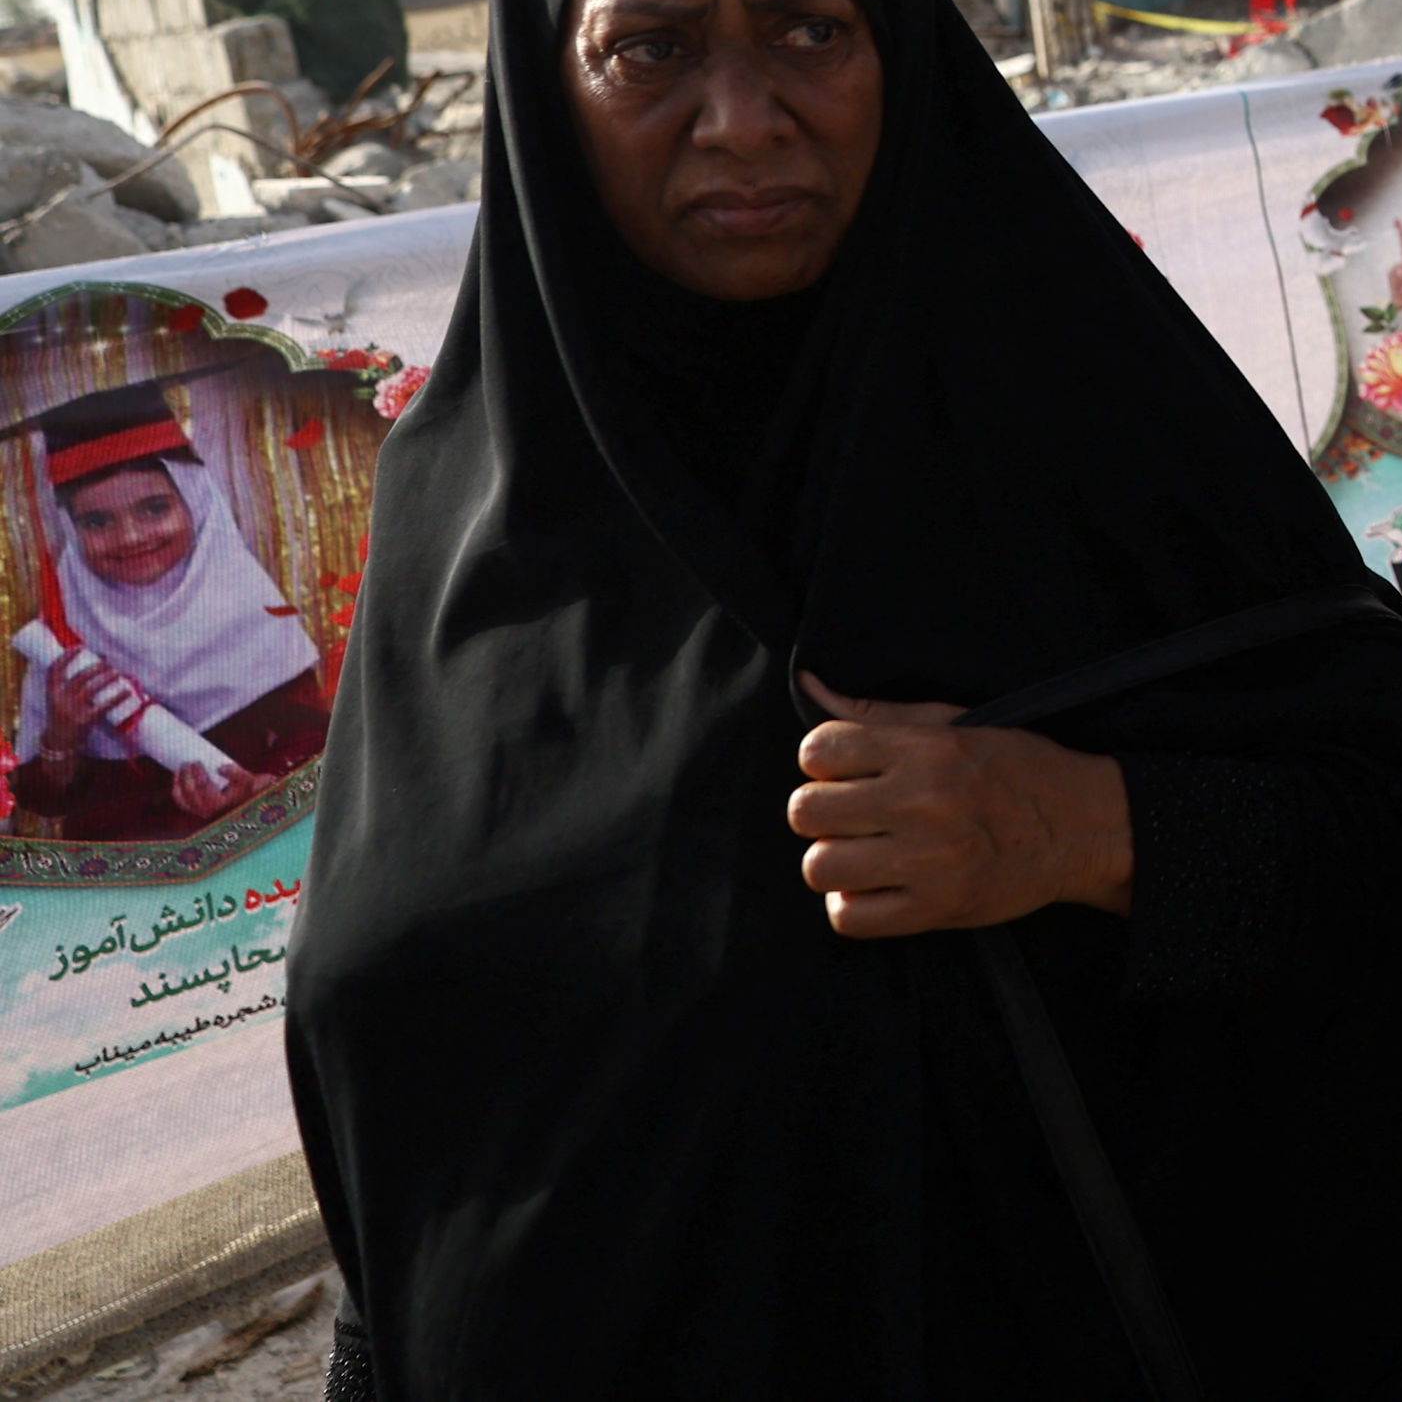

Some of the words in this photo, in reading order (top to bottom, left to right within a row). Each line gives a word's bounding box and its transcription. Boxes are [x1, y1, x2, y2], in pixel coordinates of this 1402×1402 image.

[212, 994, 278, 1029] شجره
[153, 1016, 211, 1046] طیبه
[74, 1039, 153, 1076] میناب
